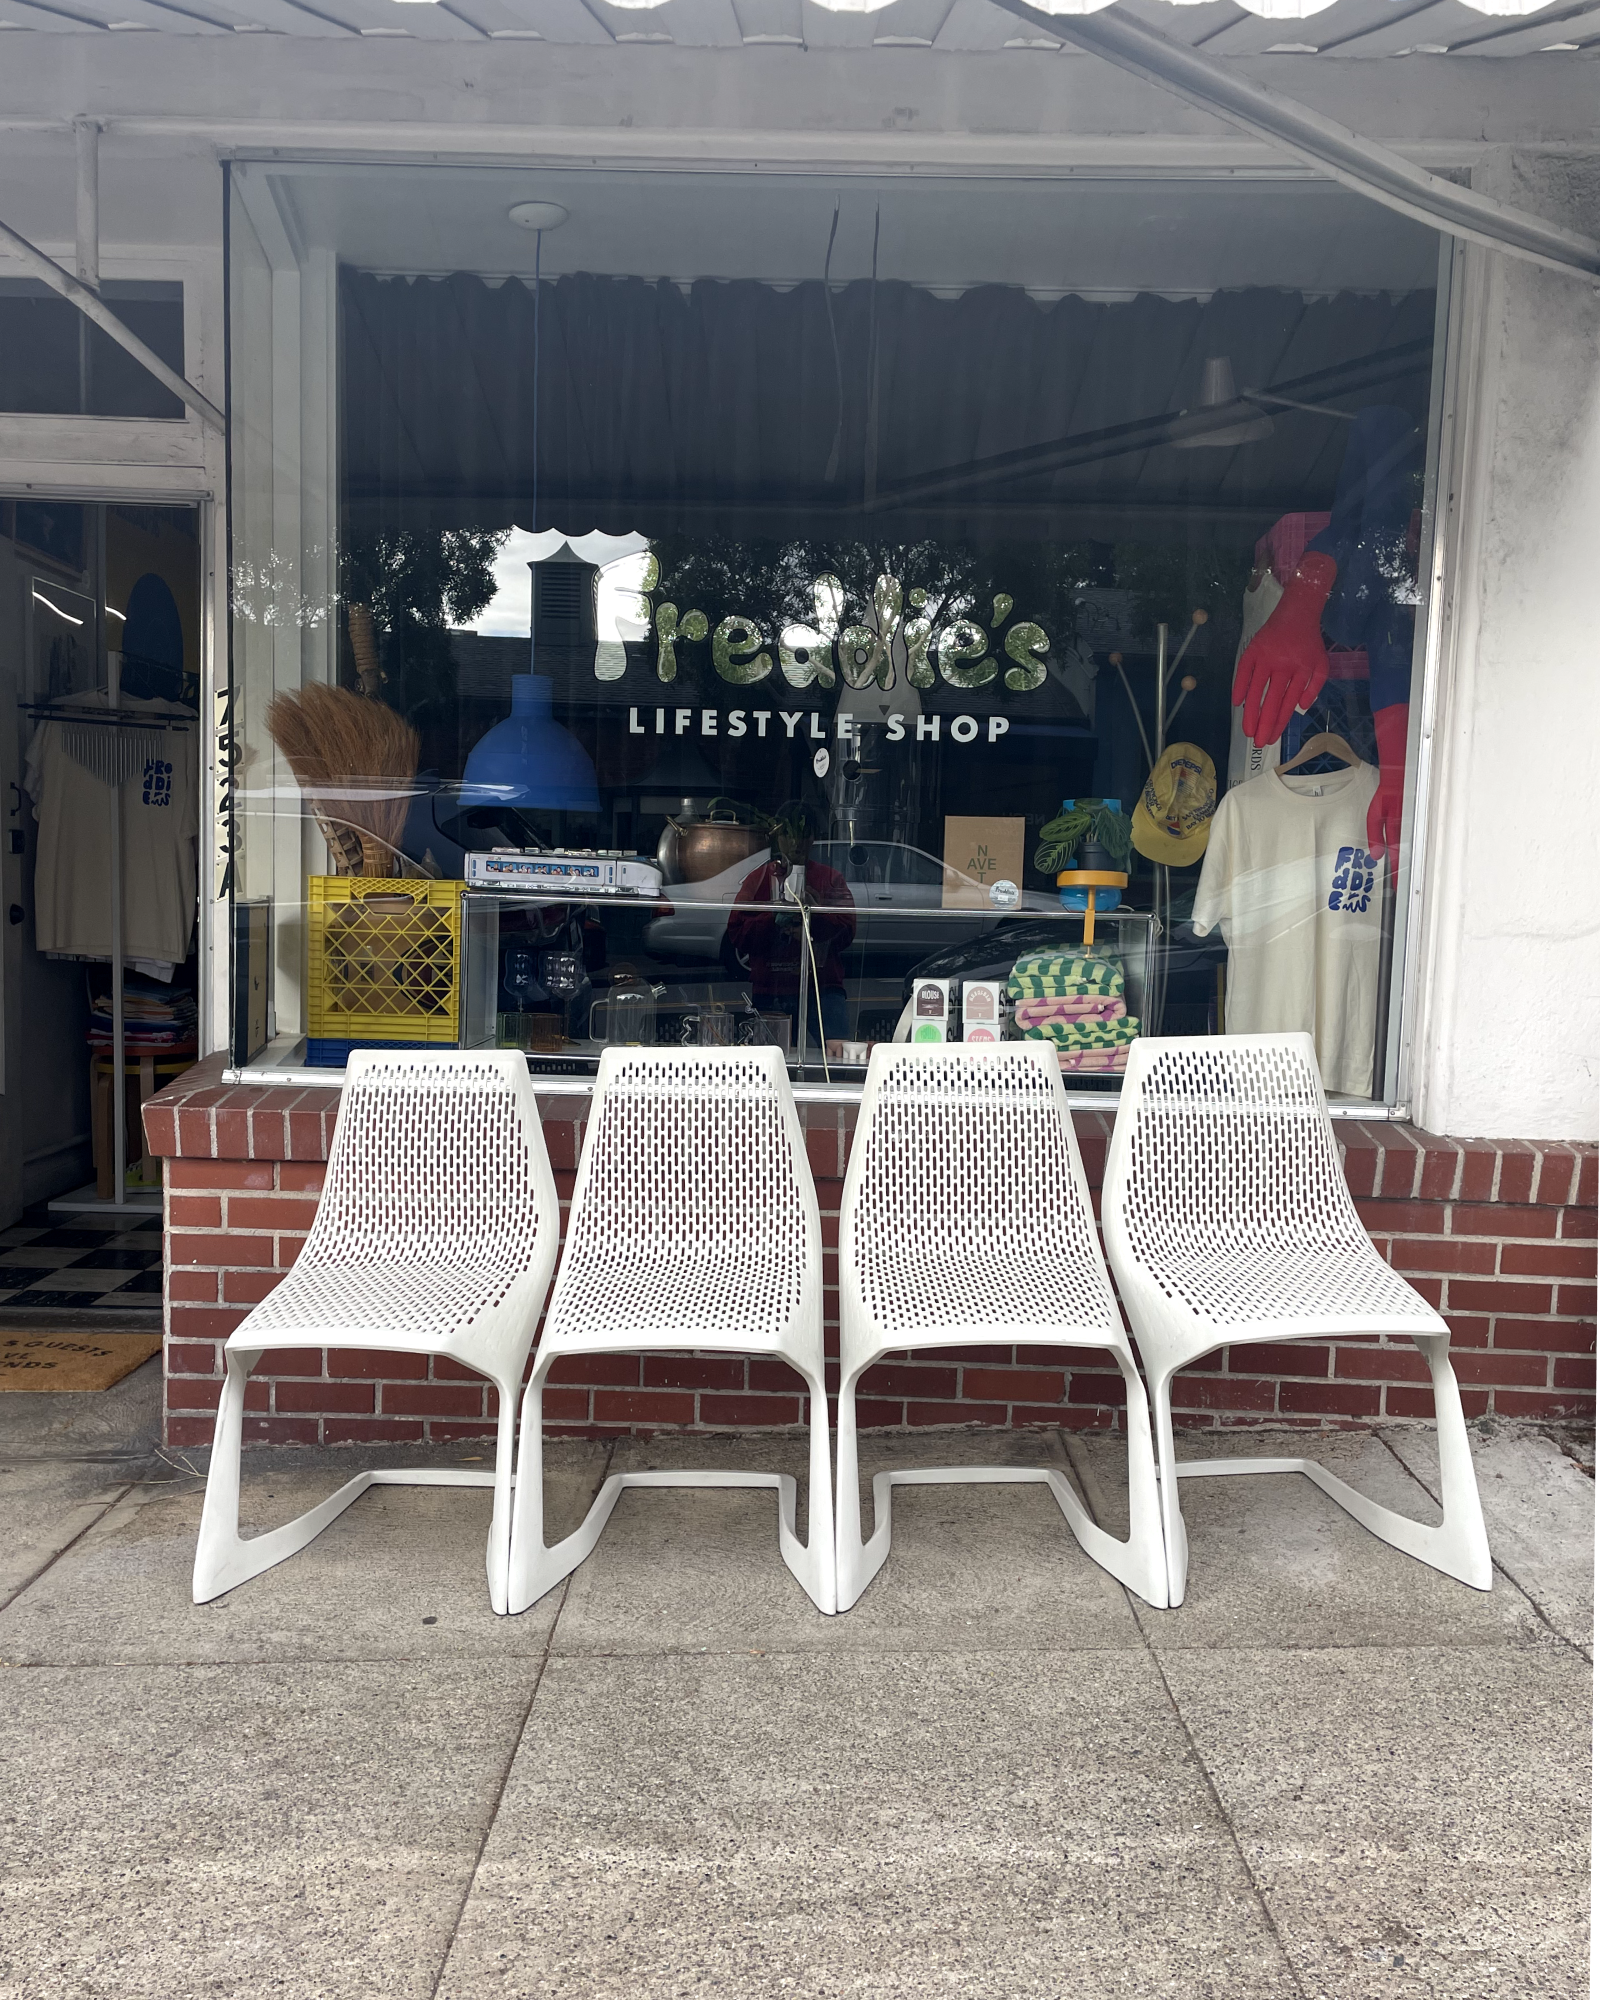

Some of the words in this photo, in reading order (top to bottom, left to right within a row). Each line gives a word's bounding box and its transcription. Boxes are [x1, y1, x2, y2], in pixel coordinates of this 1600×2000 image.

[591, 550, 1052, 691] Freddie's
[630, 707, 853, 739] LIFESTYLE
[886, 713, 1010, 742] SHOP
[977, 845, 988, 857] N
[967, 858, 997, 870] AVE
